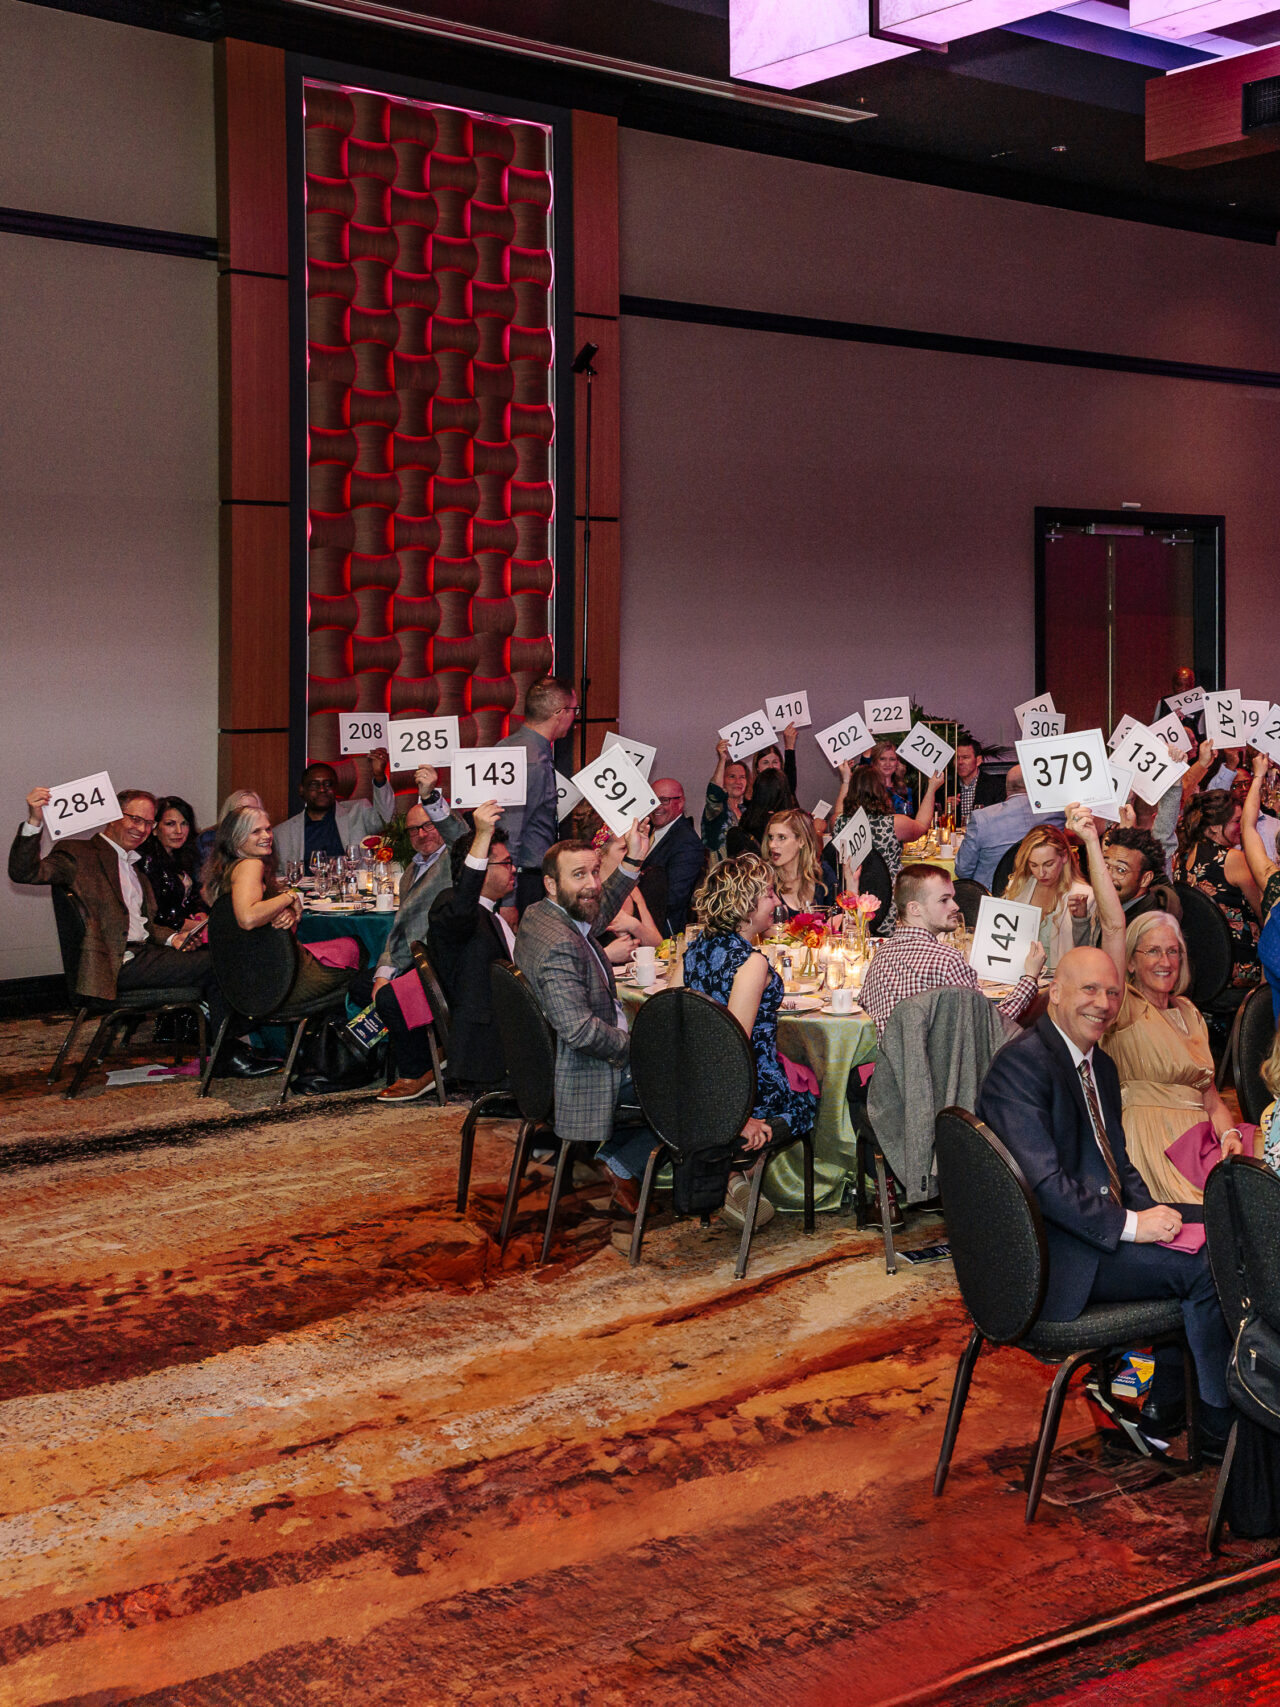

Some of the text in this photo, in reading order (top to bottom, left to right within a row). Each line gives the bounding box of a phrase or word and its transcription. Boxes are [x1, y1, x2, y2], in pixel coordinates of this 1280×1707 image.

[775, 700, 803, 720] 410
[1174, 692, 1203, 707] 162
[872, 706, 903, 722] 222
[1217, 700, 1236, 738] 247
[348, 722, 383, 740] 208
[400, 729, 449, 753] 285
[730, 721, 764, 747] 238
[827, 725, 862, 753] 202
[1030, 720, 1059, 737] 305
[911, 735, 943, 764] 201
[1128, 743, 1168, 782] 131
[465, 761, 516, 787] 143
[1033, 751, 1092, 787] 379
[53, 786, 106, 820] 284
[594, 767, 637, 816] 163
[848, 824, 867, 857] 409
[987, 913, 1019, 966] 142
